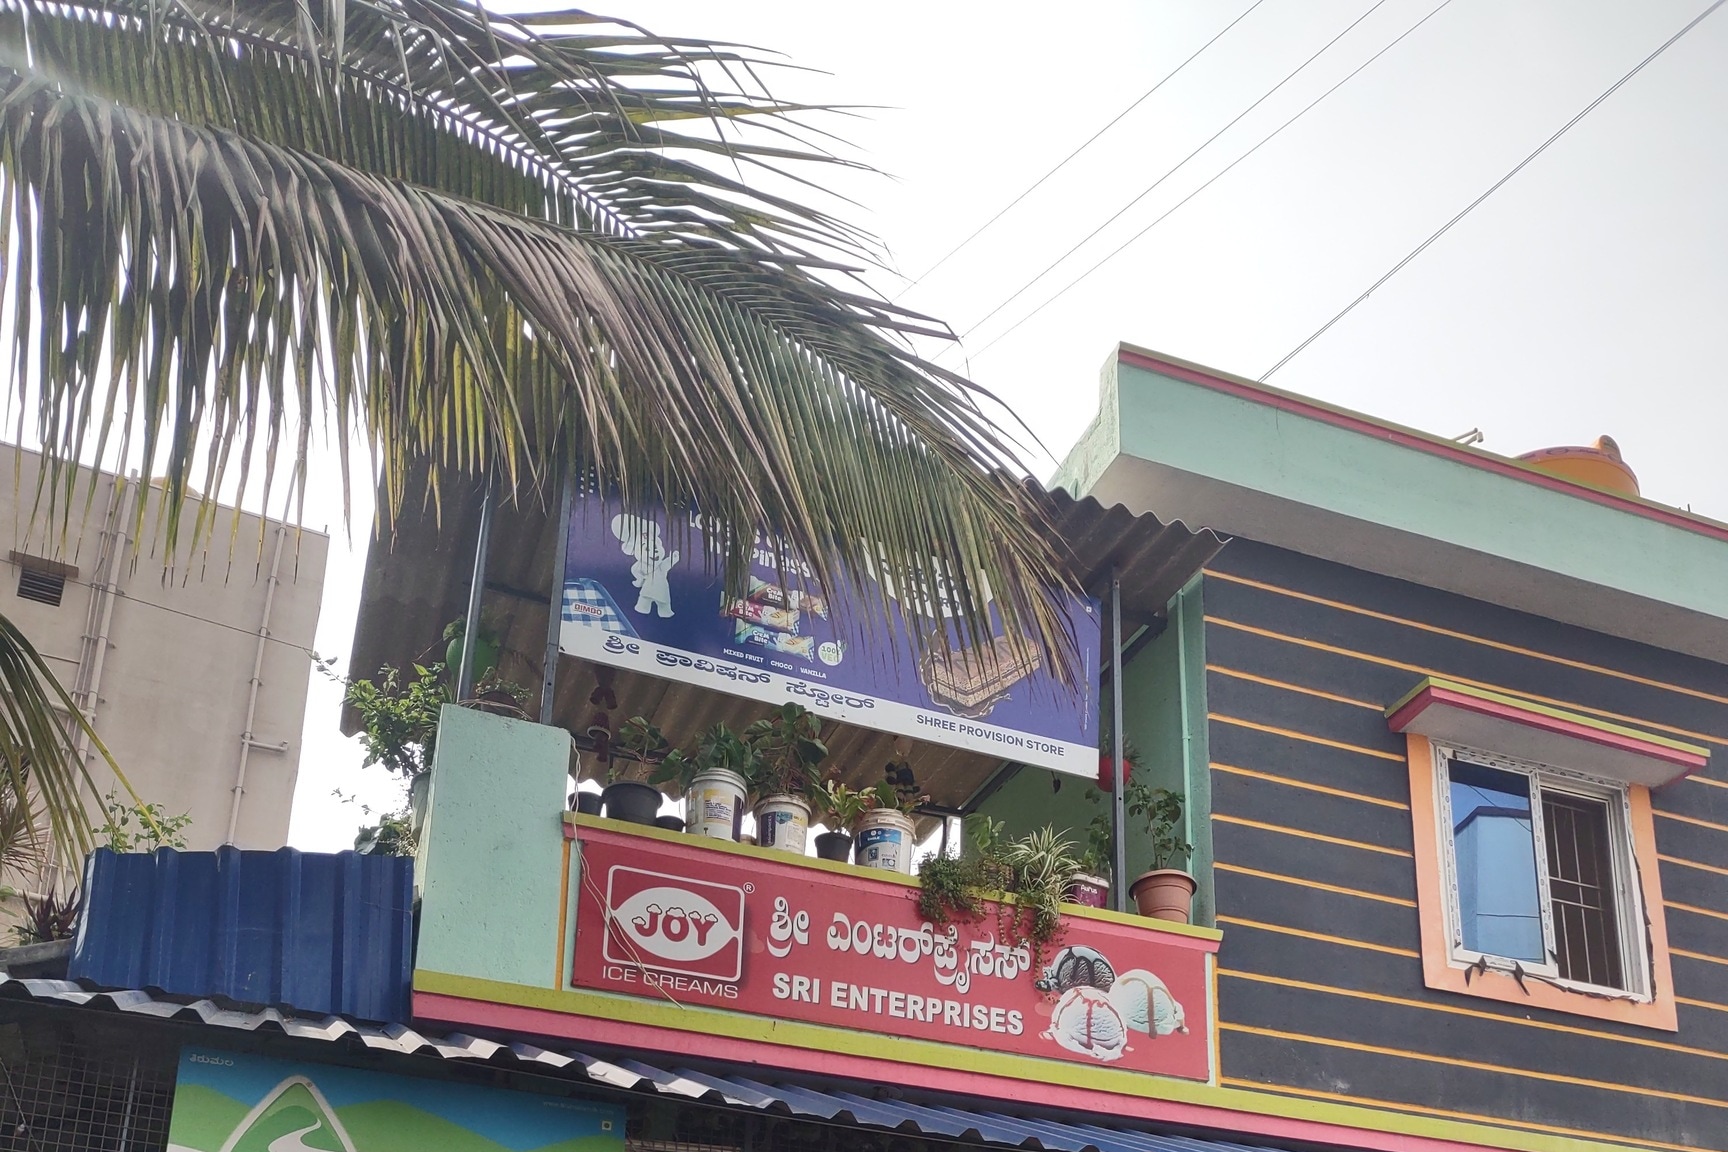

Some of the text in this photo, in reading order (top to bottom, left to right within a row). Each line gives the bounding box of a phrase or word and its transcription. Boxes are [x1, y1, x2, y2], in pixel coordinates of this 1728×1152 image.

[602, 635, 640, 655] ಶ್ರೀ
[723, 648, 764, 663] MIXED FRUIT
[770, 660, 793, 671] CHOCO
[800, 667, 827, 679] VANILLA
[915, 714, 1065, 757] SHREE PROVISION STORE
[631, 903, 719, 947] JOY
[766, 896, 810, 958] ಶ್ರೀ
[602, 965, 739, 999] ICE CREAMS
[772, 972, 1025, 1036] SRI ENTERPRISES
